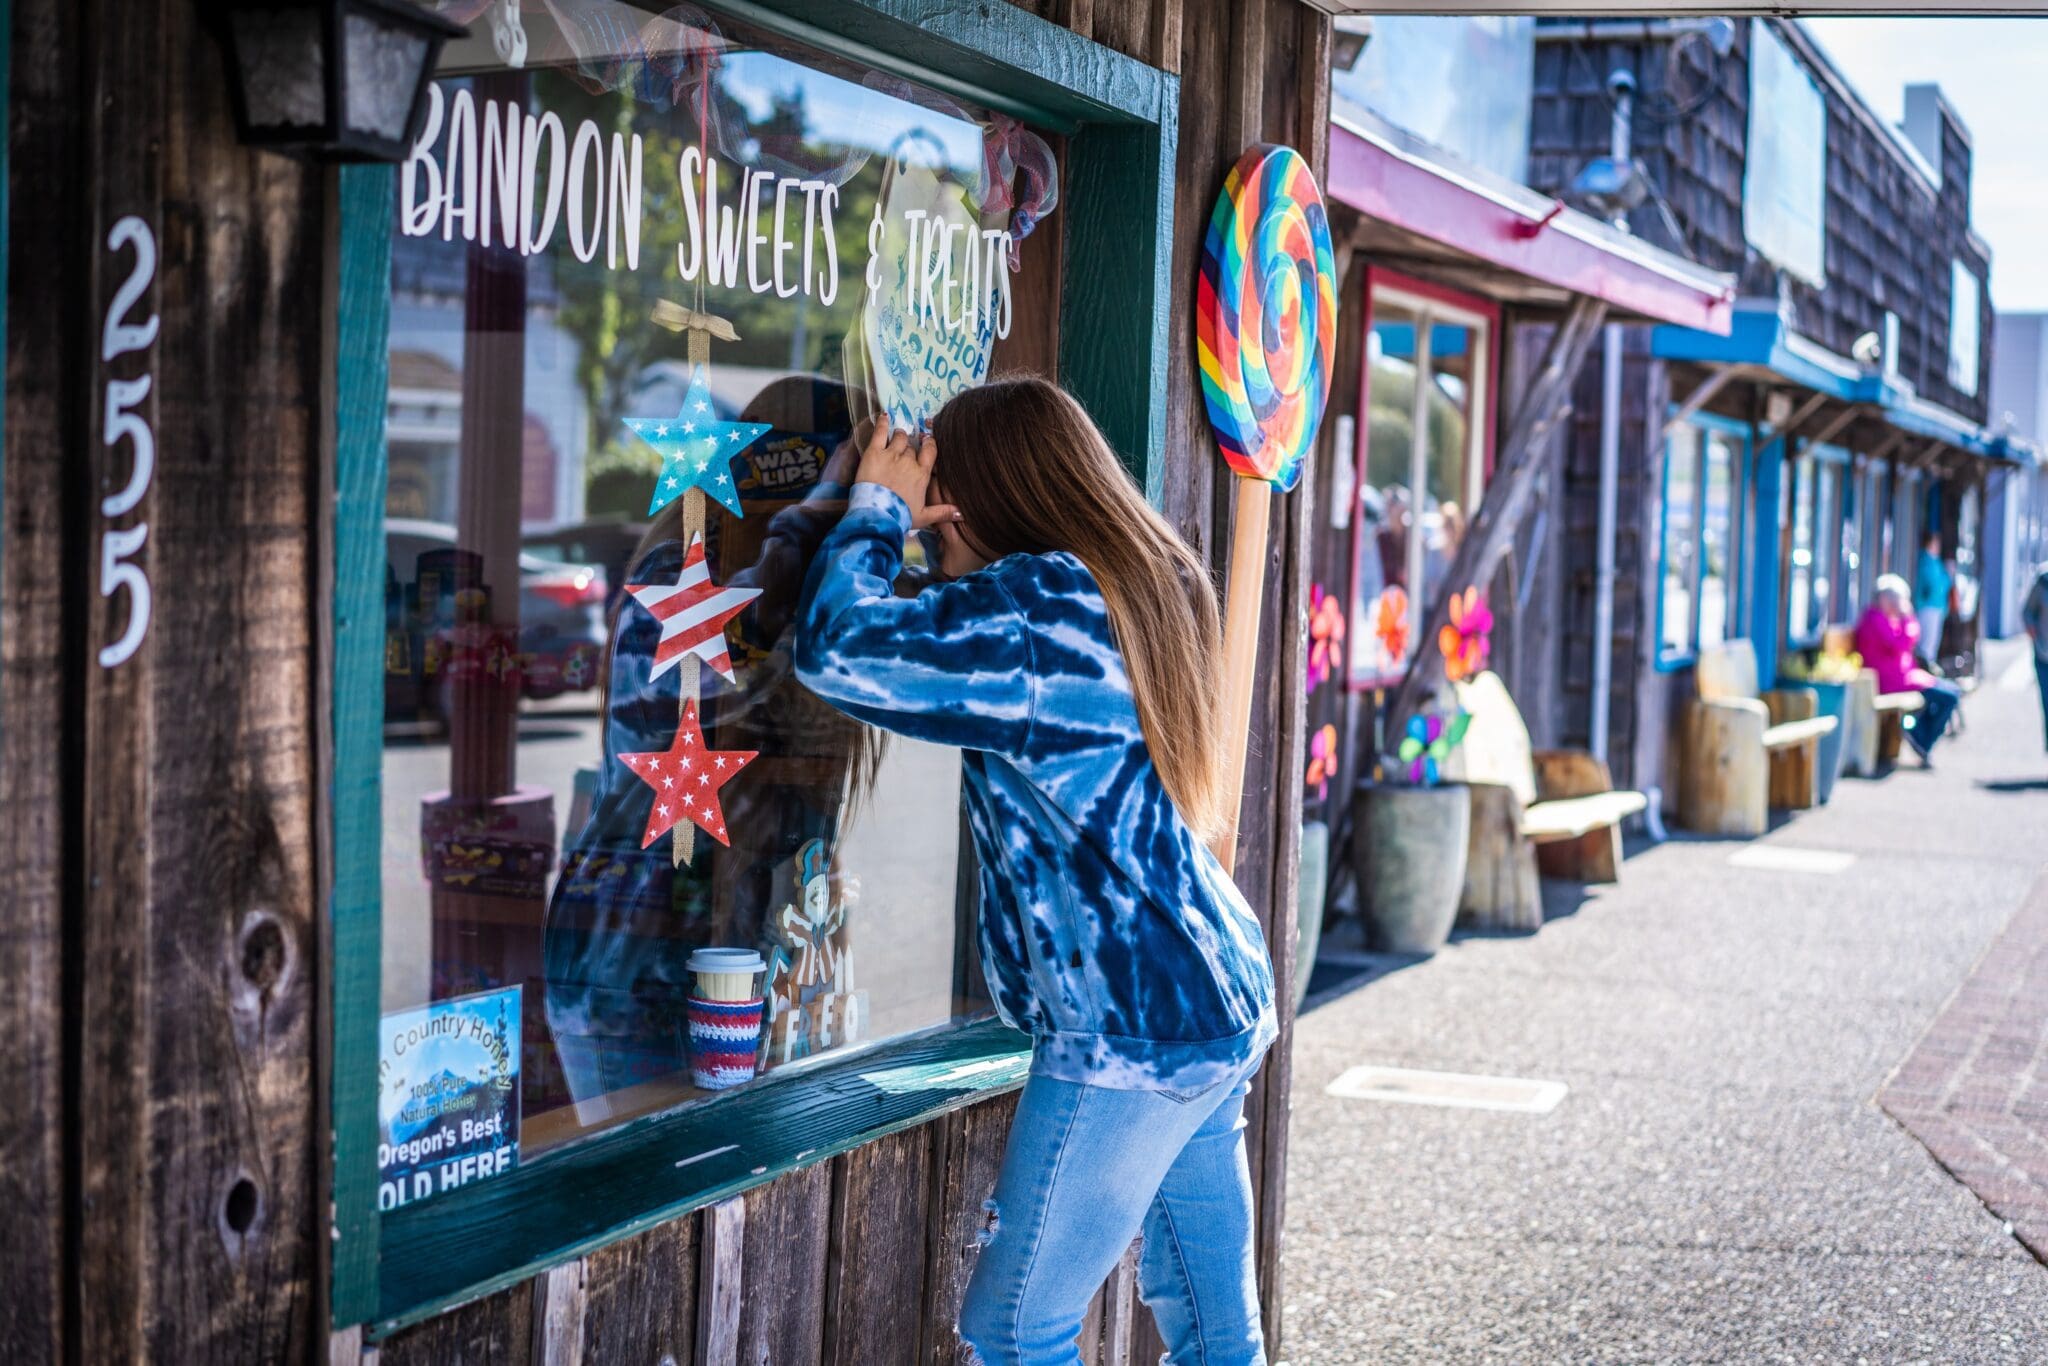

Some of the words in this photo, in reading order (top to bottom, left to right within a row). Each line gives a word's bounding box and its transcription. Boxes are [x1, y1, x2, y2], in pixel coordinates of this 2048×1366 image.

[401, 81, 643, 271] BANDON
[677, 146, 839, 306] SWEETS
[866, 202, 885, 307] &
[904, 209, 1013, 341] TREATS
[100, 215, 159, 668] 255
[754, 445, 817, 470] WAX
[762, 462, 819, 487] LIPS
[394, 1012, 466, 1056] Country
[471, 1018, 513, 1090] Honey
[410, 1078, 438, 1101] 100%
[441, 1074, 468, 1091] Pure
[400, 1100, 439, 1125] Natural
[378, 1125, 456, 1169] Oregon's
[461, 1114, 502, 1144] Best
[378, 1171, 432, 1212] OLD
